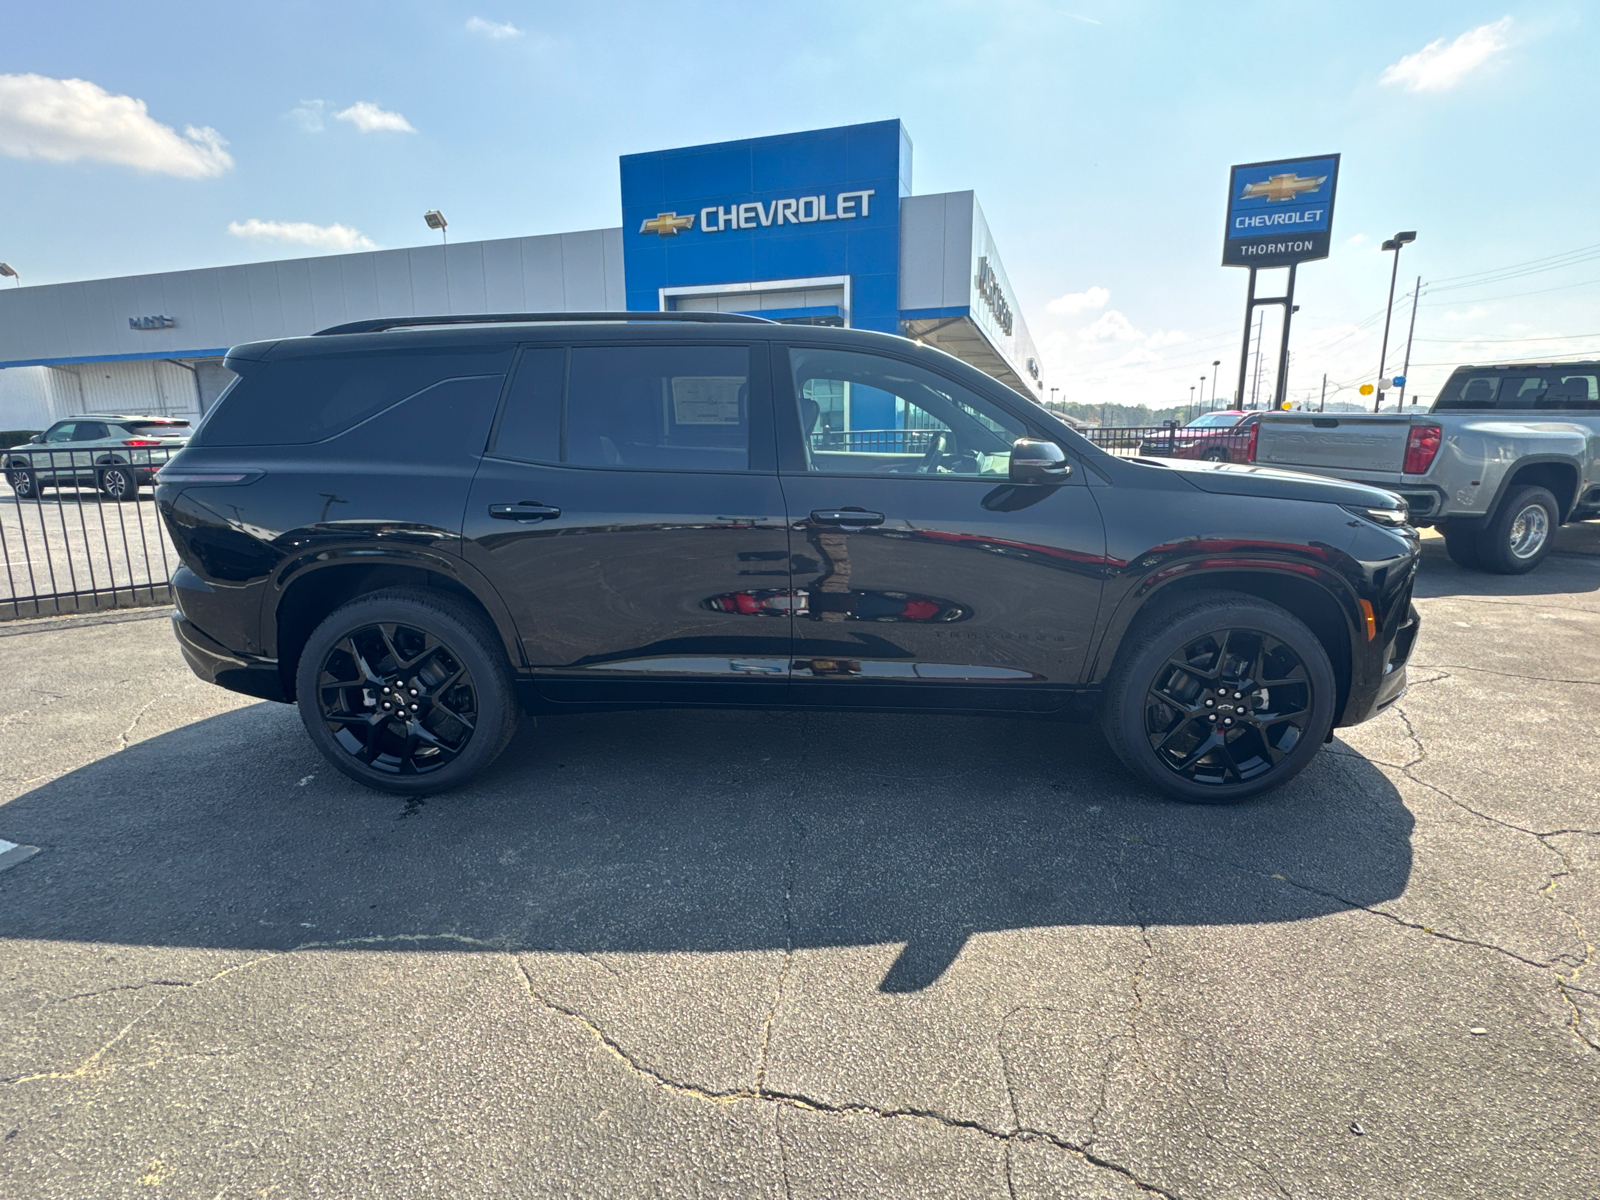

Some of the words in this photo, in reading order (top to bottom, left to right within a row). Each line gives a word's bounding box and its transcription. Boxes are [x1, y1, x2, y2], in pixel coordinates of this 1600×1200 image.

[700, 189, 875, 233] CHEVROLET
[1235, 209, 1324, 229] CHEVROLET
[1240, 240, 1313, 256] THORNTON
[1264, 432, 1394, 447] CHEVROLET
